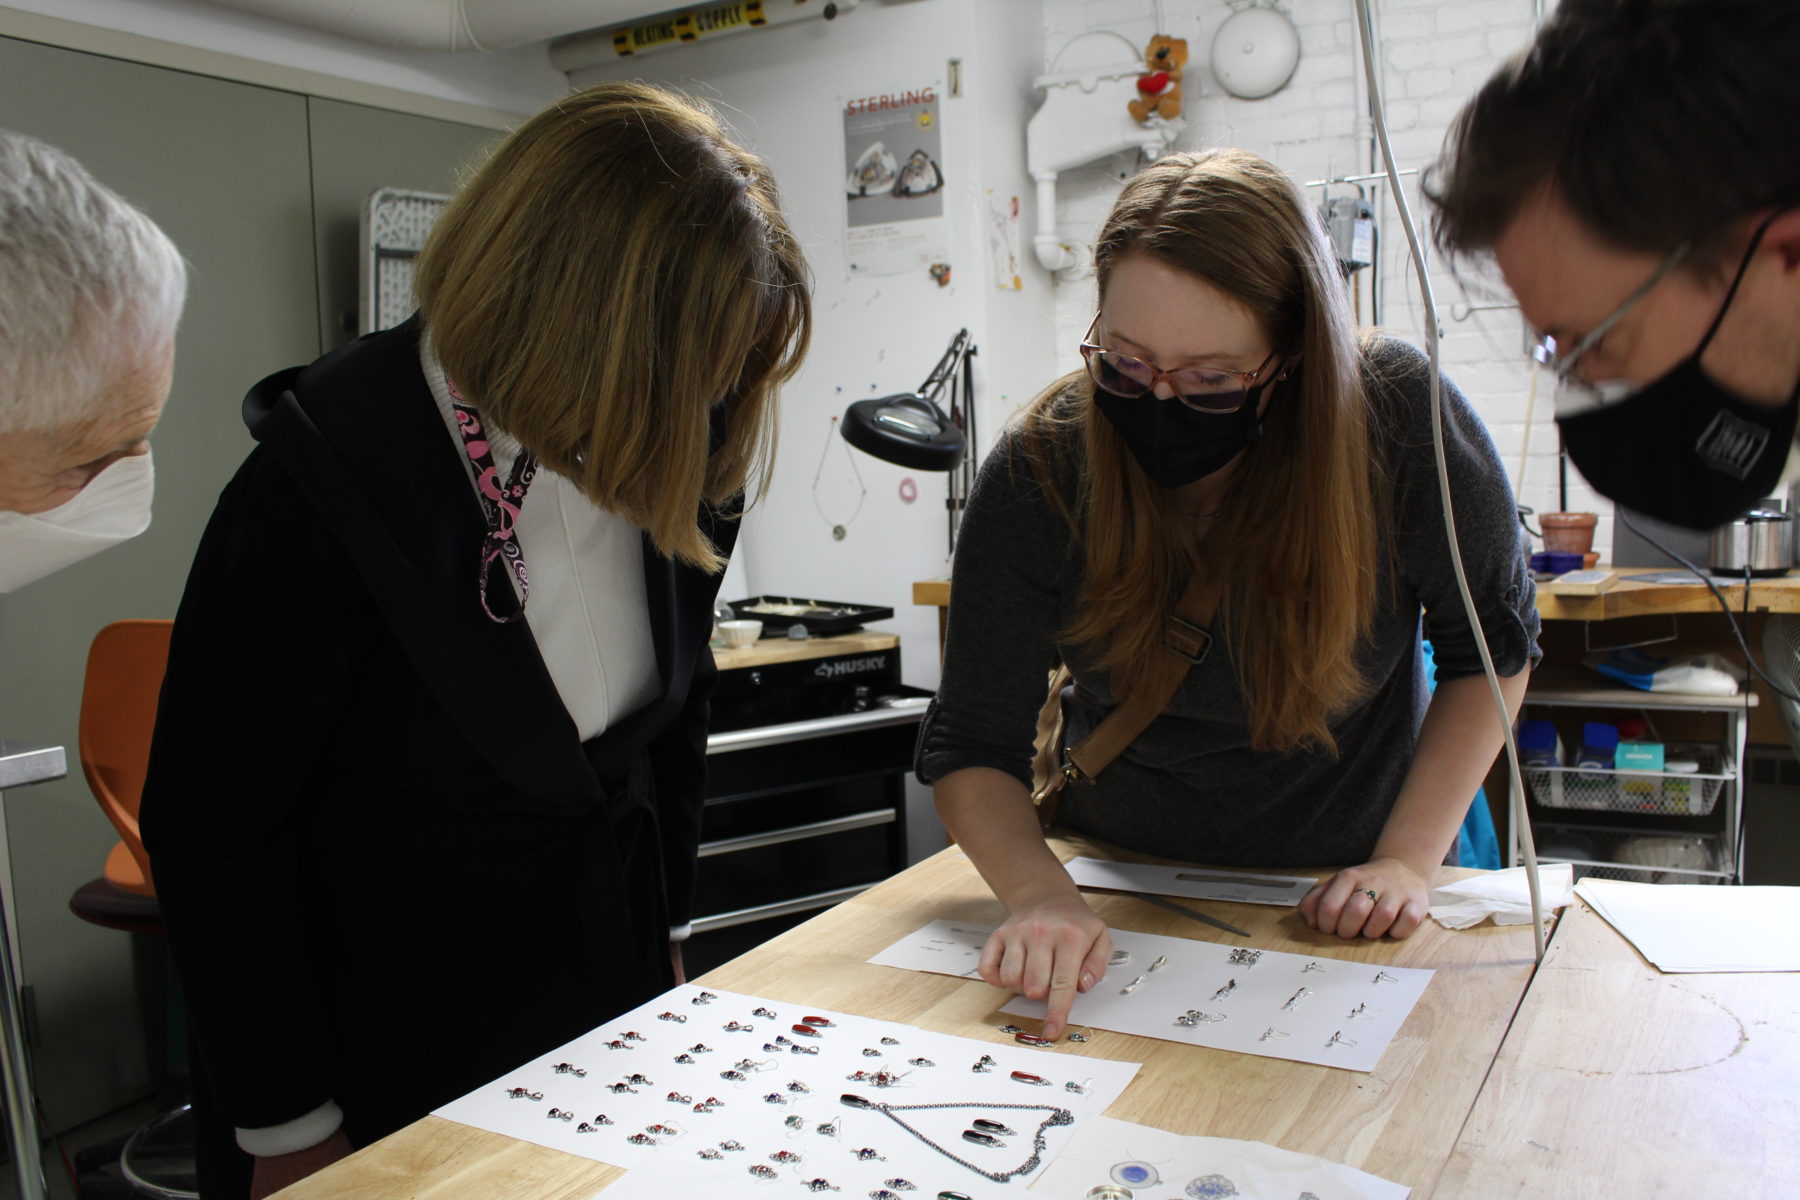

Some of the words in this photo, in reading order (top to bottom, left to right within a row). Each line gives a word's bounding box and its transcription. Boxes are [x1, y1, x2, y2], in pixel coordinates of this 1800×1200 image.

[633, 20, 675, 46] HEATING
[696, 5, 742, 31] SUPPLY
[846, 87, 936, 116] STERLING
[834, 656, 886, 675] HUSKY
